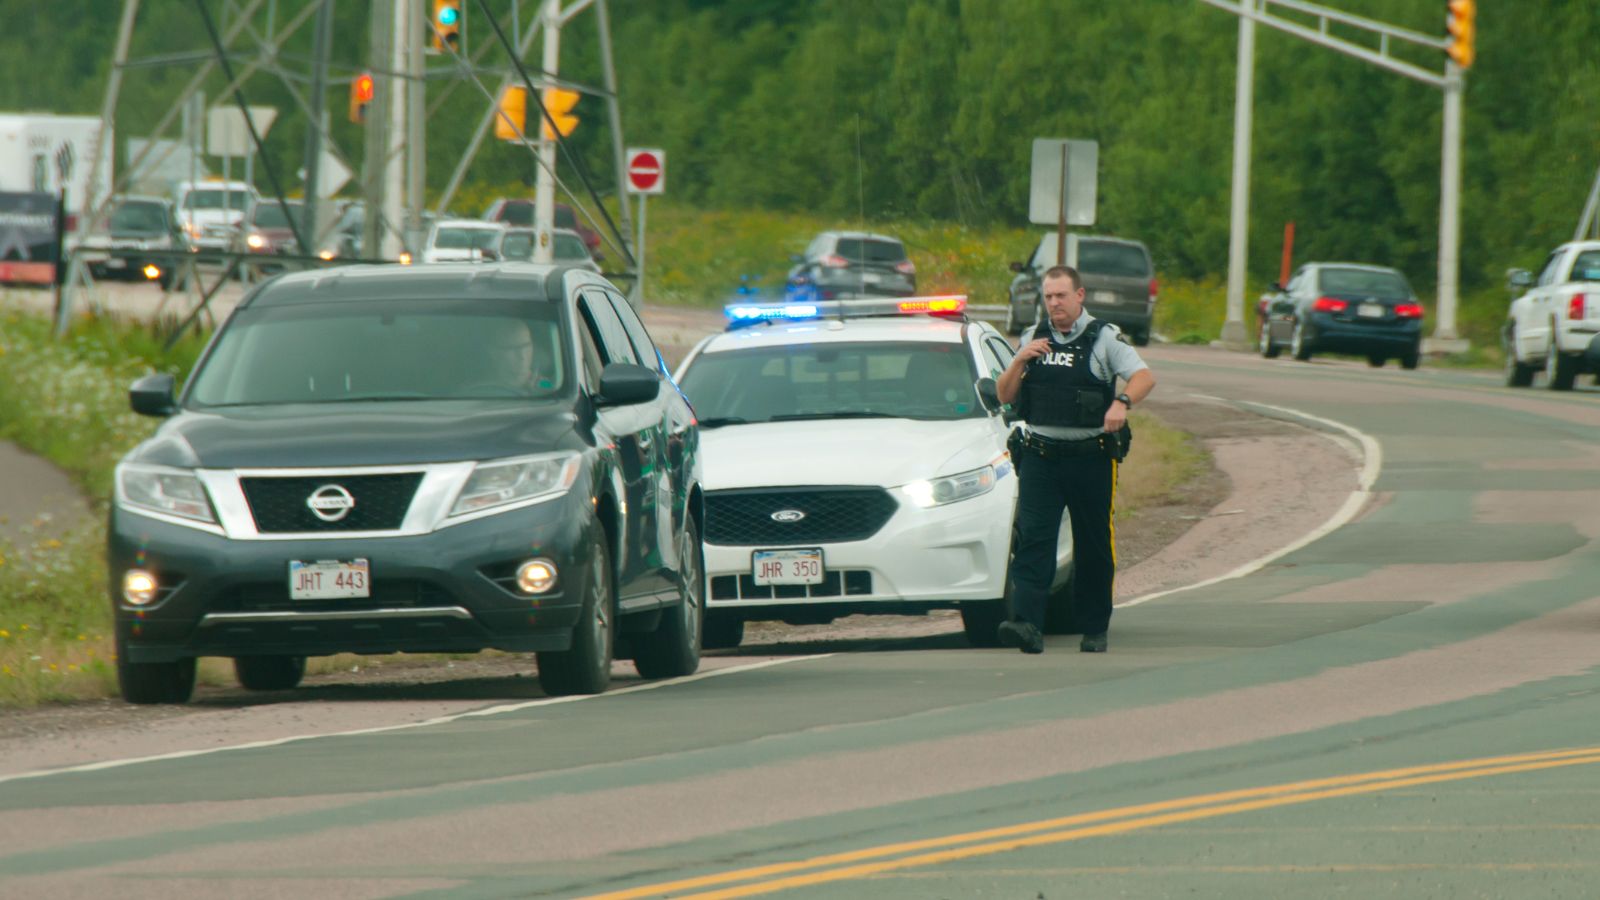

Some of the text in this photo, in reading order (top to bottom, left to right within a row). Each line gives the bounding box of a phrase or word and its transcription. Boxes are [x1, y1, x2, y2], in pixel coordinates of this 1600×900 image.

[758, 560, 818, 578] JHR 350
[296, 571, 363, 591] JHT 443
